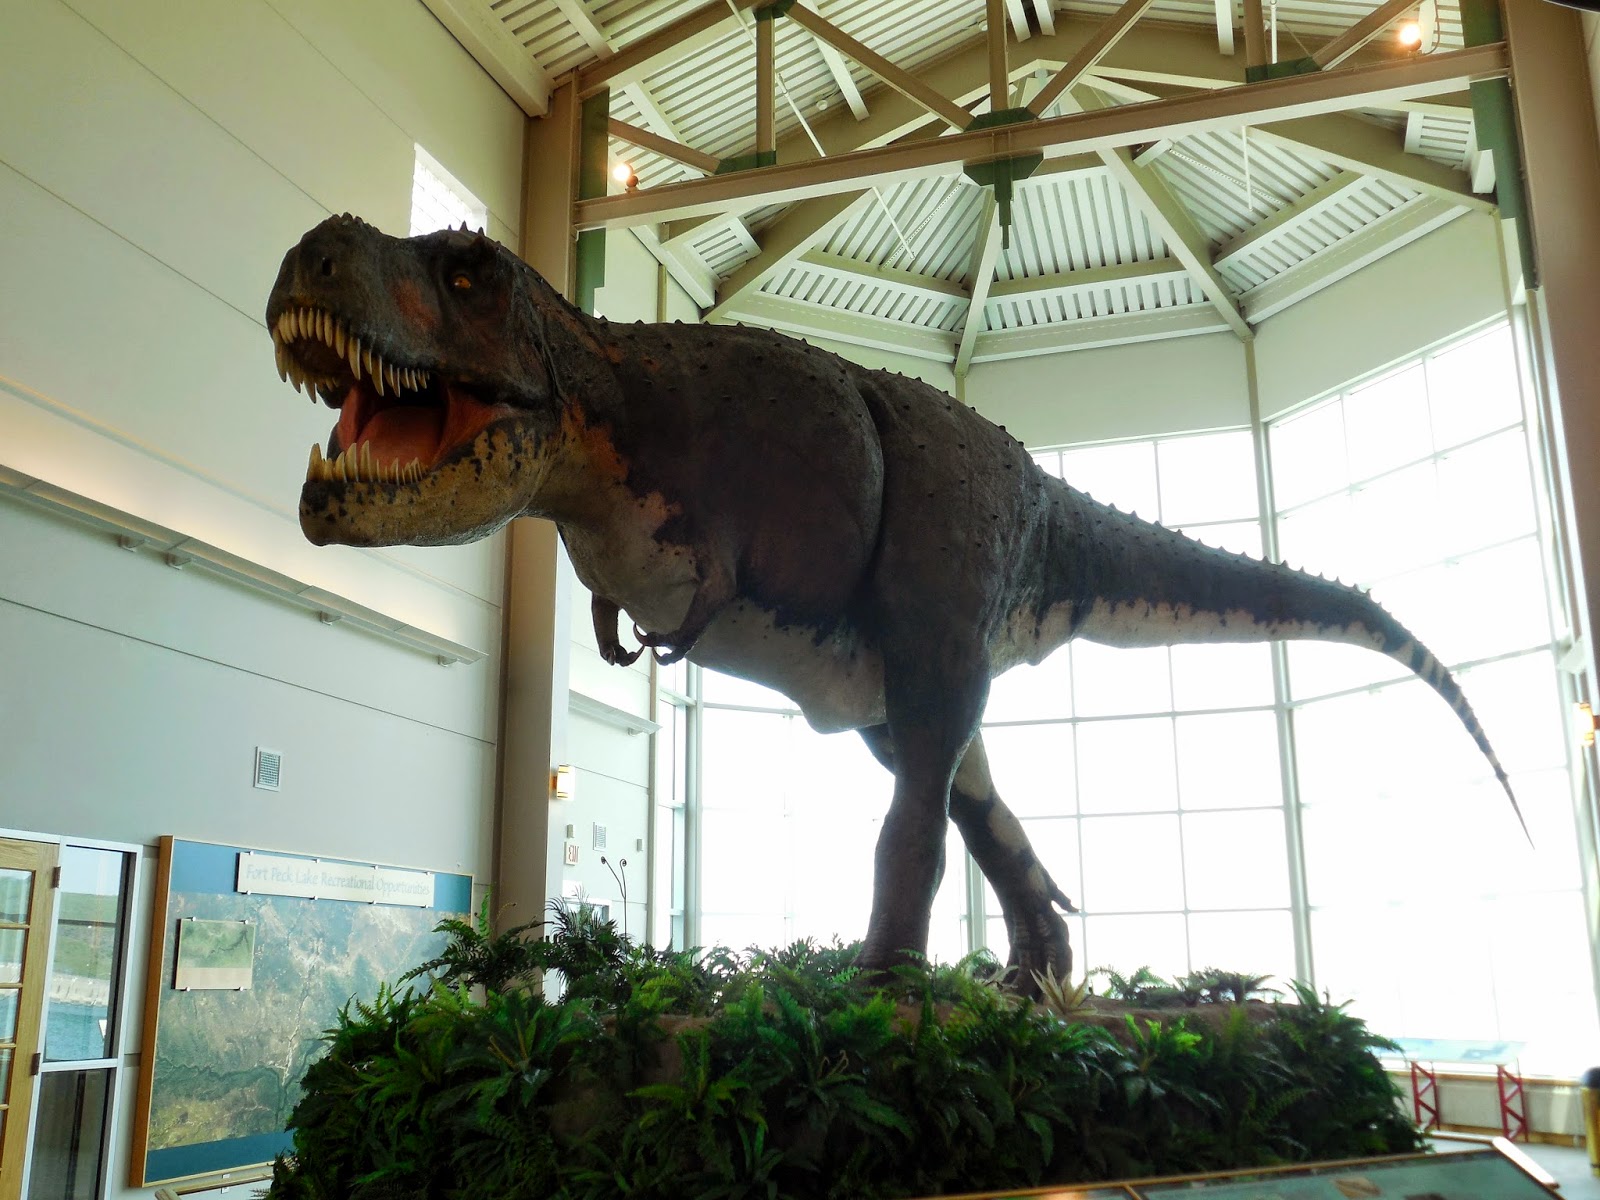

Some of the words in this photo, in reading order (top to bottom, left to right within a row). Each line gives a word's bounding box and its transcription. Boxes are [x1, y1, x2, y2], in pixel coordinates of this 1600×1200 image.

[246, 864, 268, 881] Fort
[271, 866, 292, 883] Peck
[296, 869, 318, 885] Lake
[322, 872, 375, 891] Recreational
[376, 877, 431, 897] Opportunities
